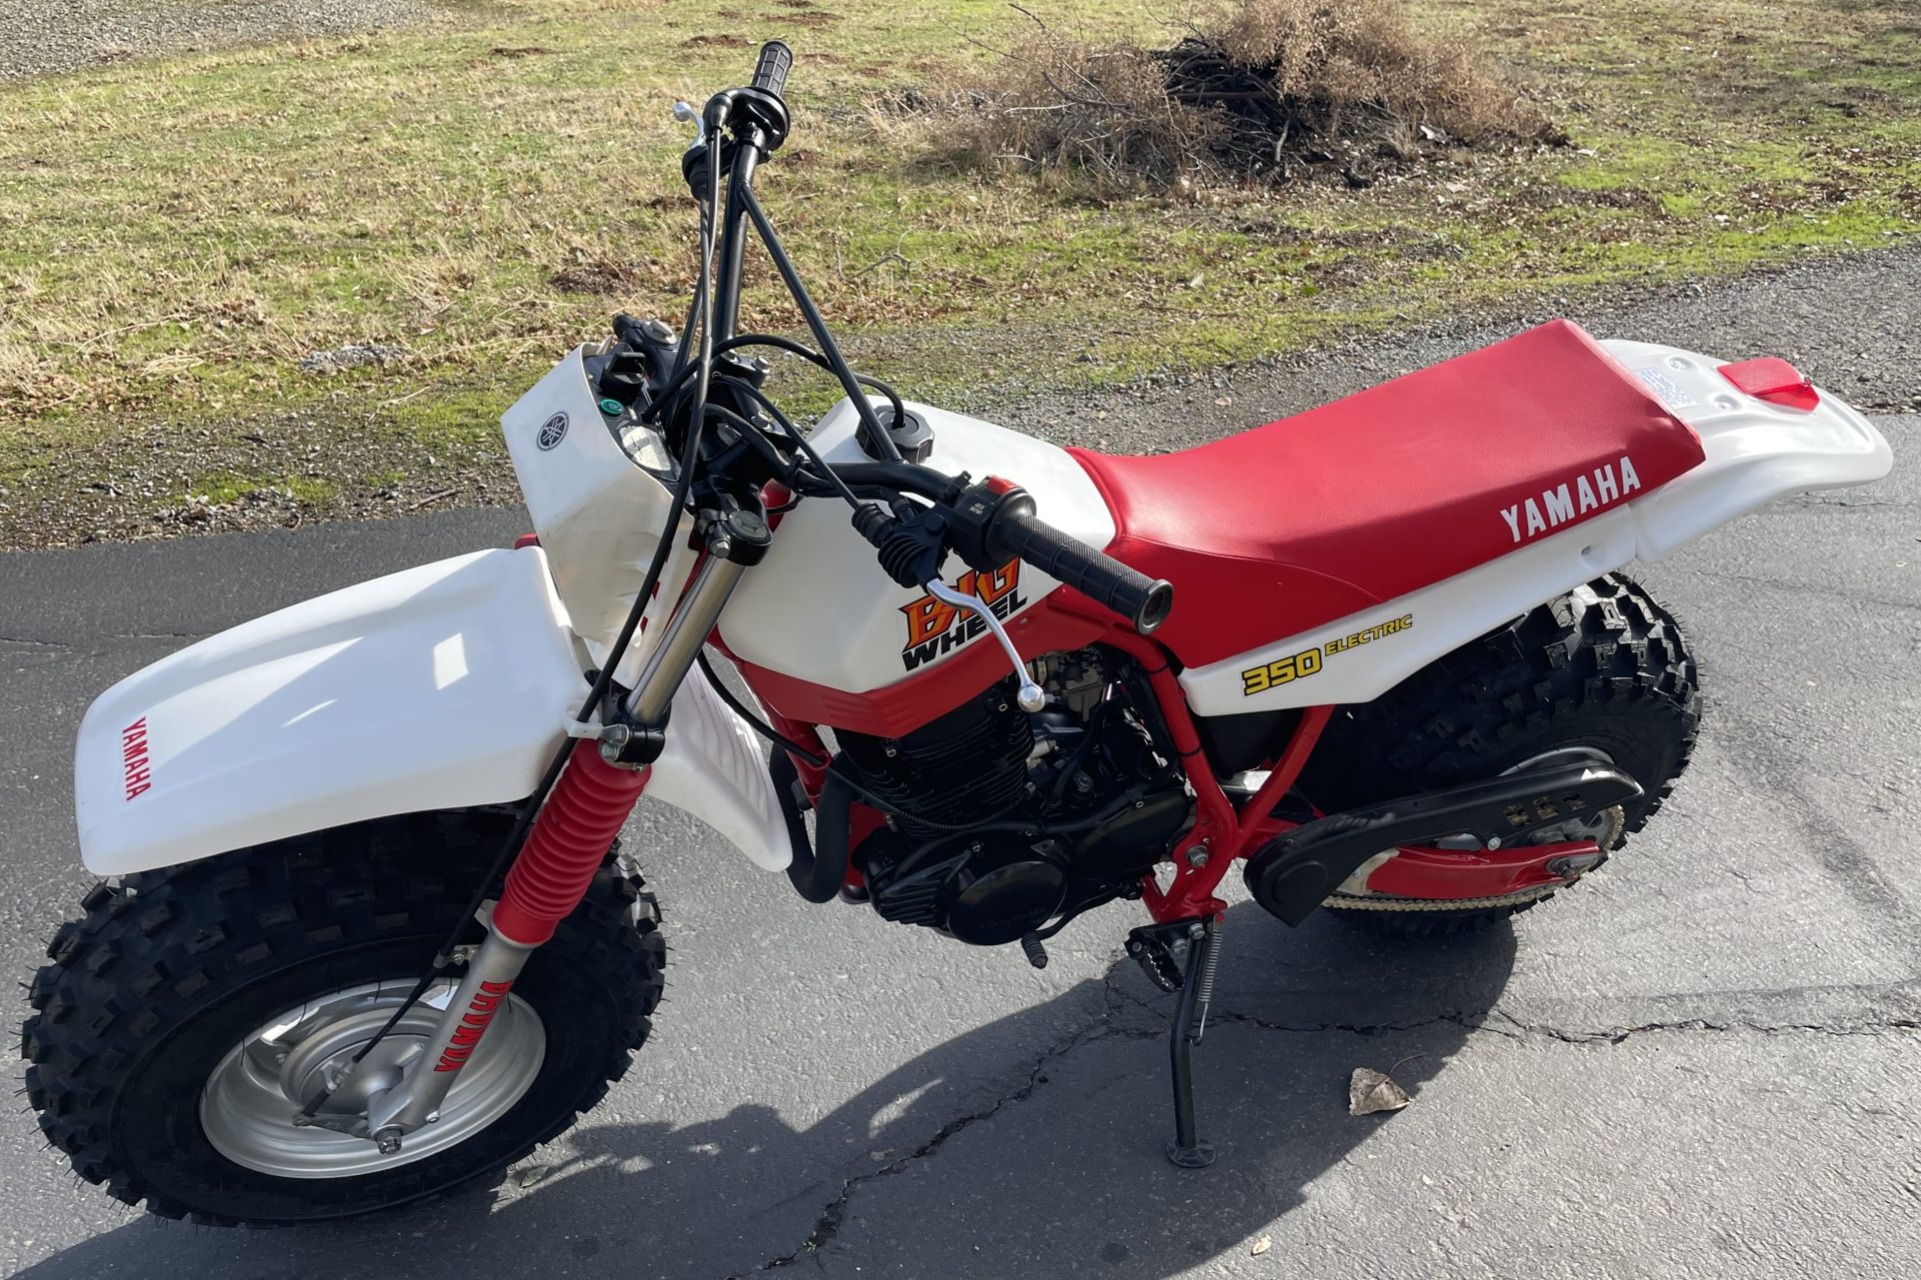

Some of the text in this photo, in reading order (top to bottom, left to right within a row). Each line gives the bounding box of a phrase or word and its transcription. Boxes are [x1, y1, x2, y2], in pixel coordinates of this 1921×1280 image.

[1500, 456, 1641, 543] YAMAHA
[898, 556, 1021, 653] BIG
[902, 589, 1028, 672] WHEEL
[1241, 613, 1413, 696] 350 ELECTRIC
[122, 716, 151, 802] YAMAHA
[433, 978, 515, 1073] YAMAHA
